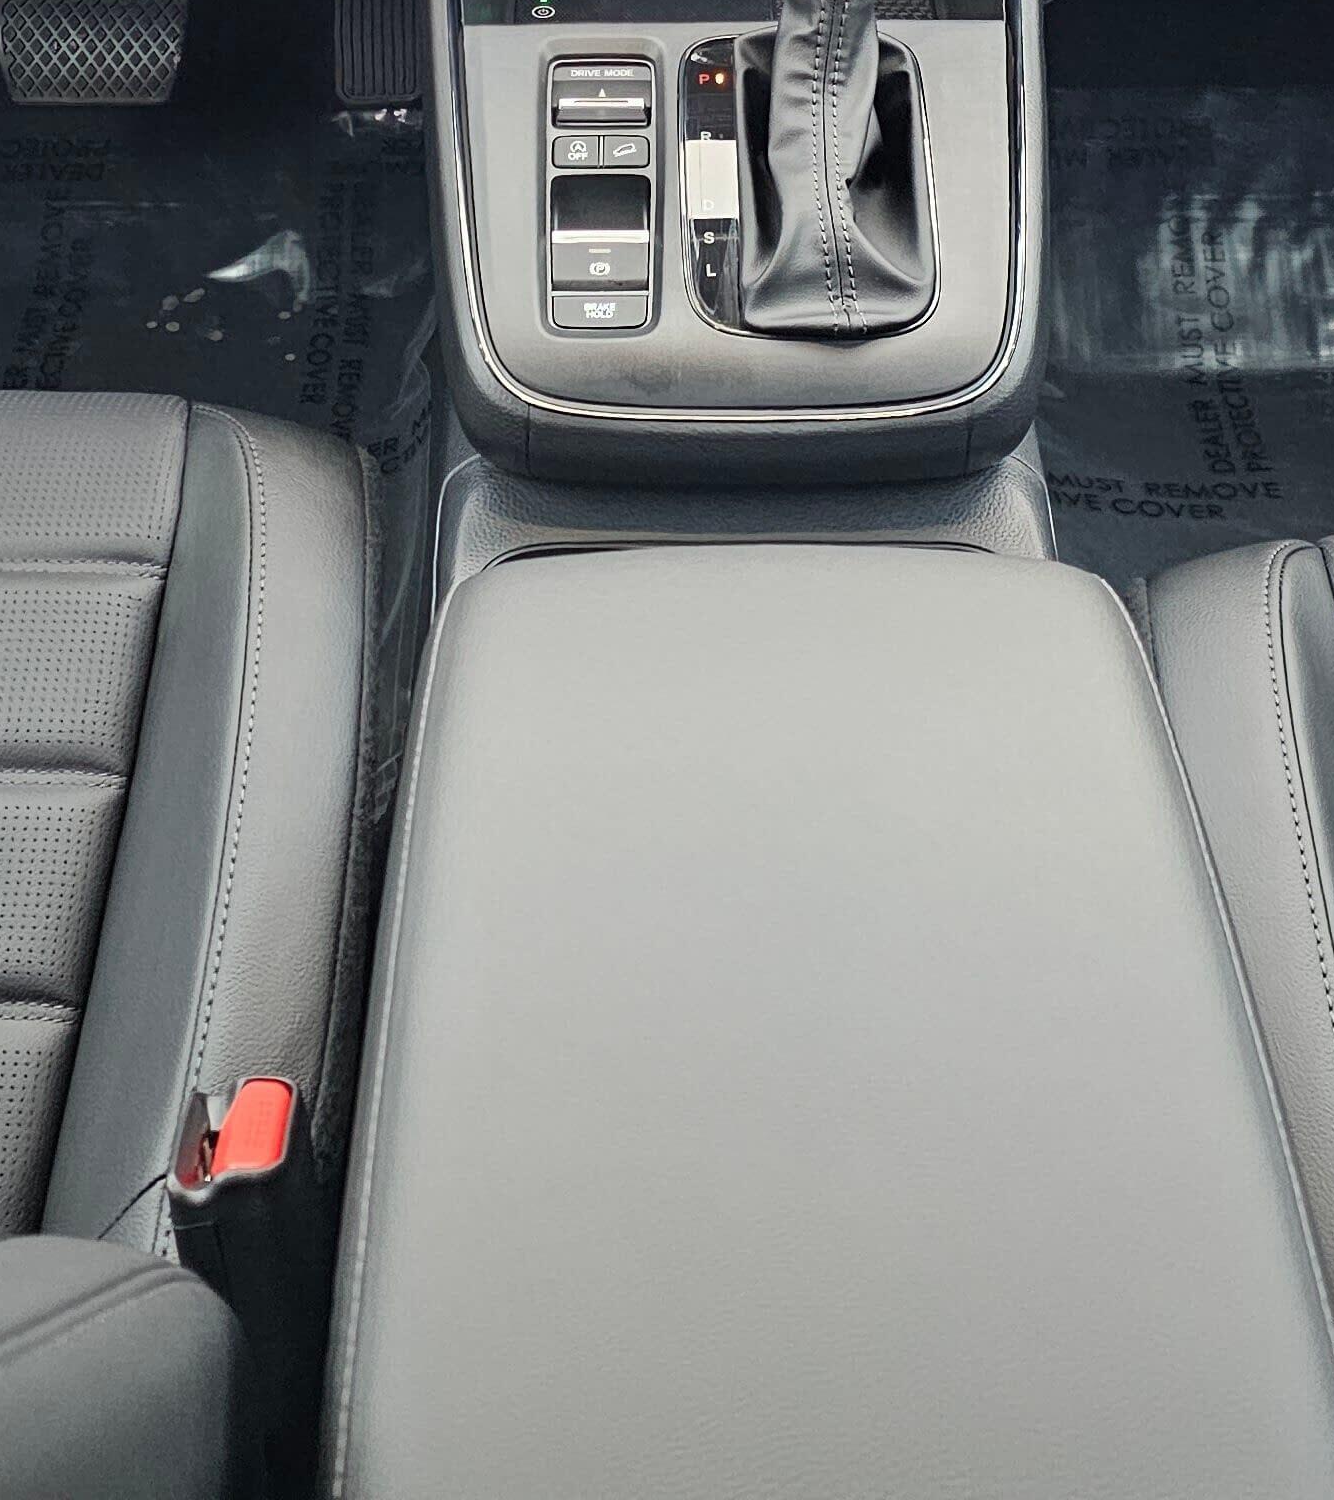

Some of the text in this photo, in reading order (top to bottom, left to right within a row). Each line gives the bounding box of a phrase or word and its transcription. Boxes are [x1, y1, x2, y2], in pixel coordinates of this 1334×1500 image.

[570, 68, 634, 78] DRIVE MODE
[698, 73, 710, 85] P
[700, 130, 713, 140] R
[566, 151, 588, 162] OFF
[703, 199, 715, 211] D
[703, 231, 715, 244] S
[705, 263, 716, 277] L
[1204, 231, 1236, 334] COVER
[583, 301, 616, 311] BRAKE
[584, 309, 616, 320] HOLD
[1175, 314, 1235, 475] DEALER MUST
[1047, 470, 1284, 501] MUST REMOVE
[1113, 499, 1226, 521] COVER
